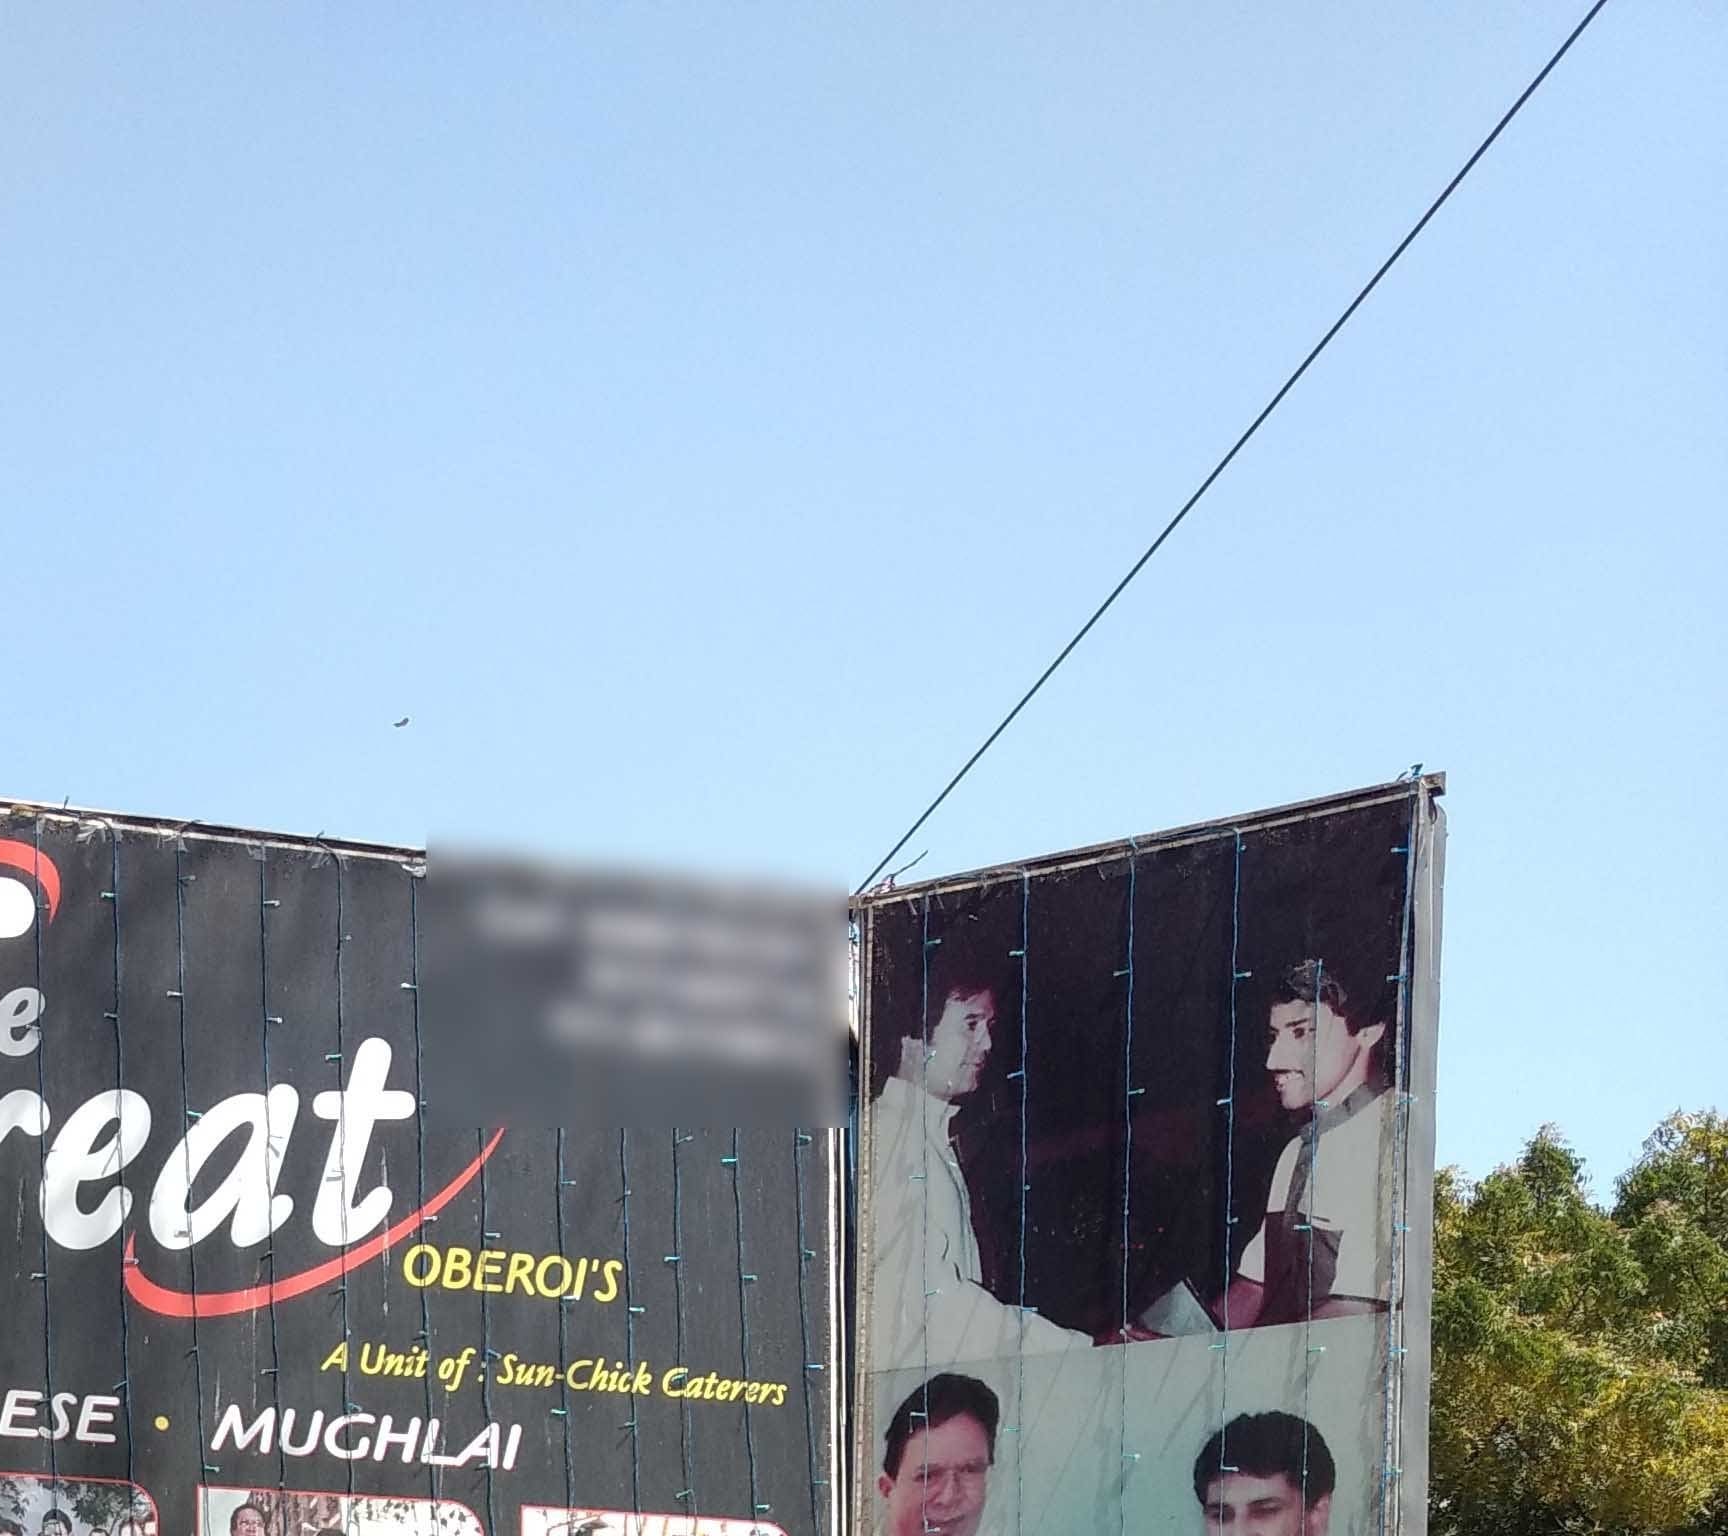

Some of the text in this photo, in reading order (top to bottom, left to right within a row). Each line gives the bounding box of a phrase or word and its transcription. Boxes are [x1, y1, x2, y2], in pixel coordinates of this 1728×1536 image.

[403, 1244, 623, 1302] OBEROI'S
[320, 1341, 347, 1372] A
[359, 1342, 430, 1378] Unit
[496, 1353, 652, 1395] Sun-Chick
[661, 1367, 788, 1406] Caterers
[211, 1404, 523, 1471] MUGHLAI
